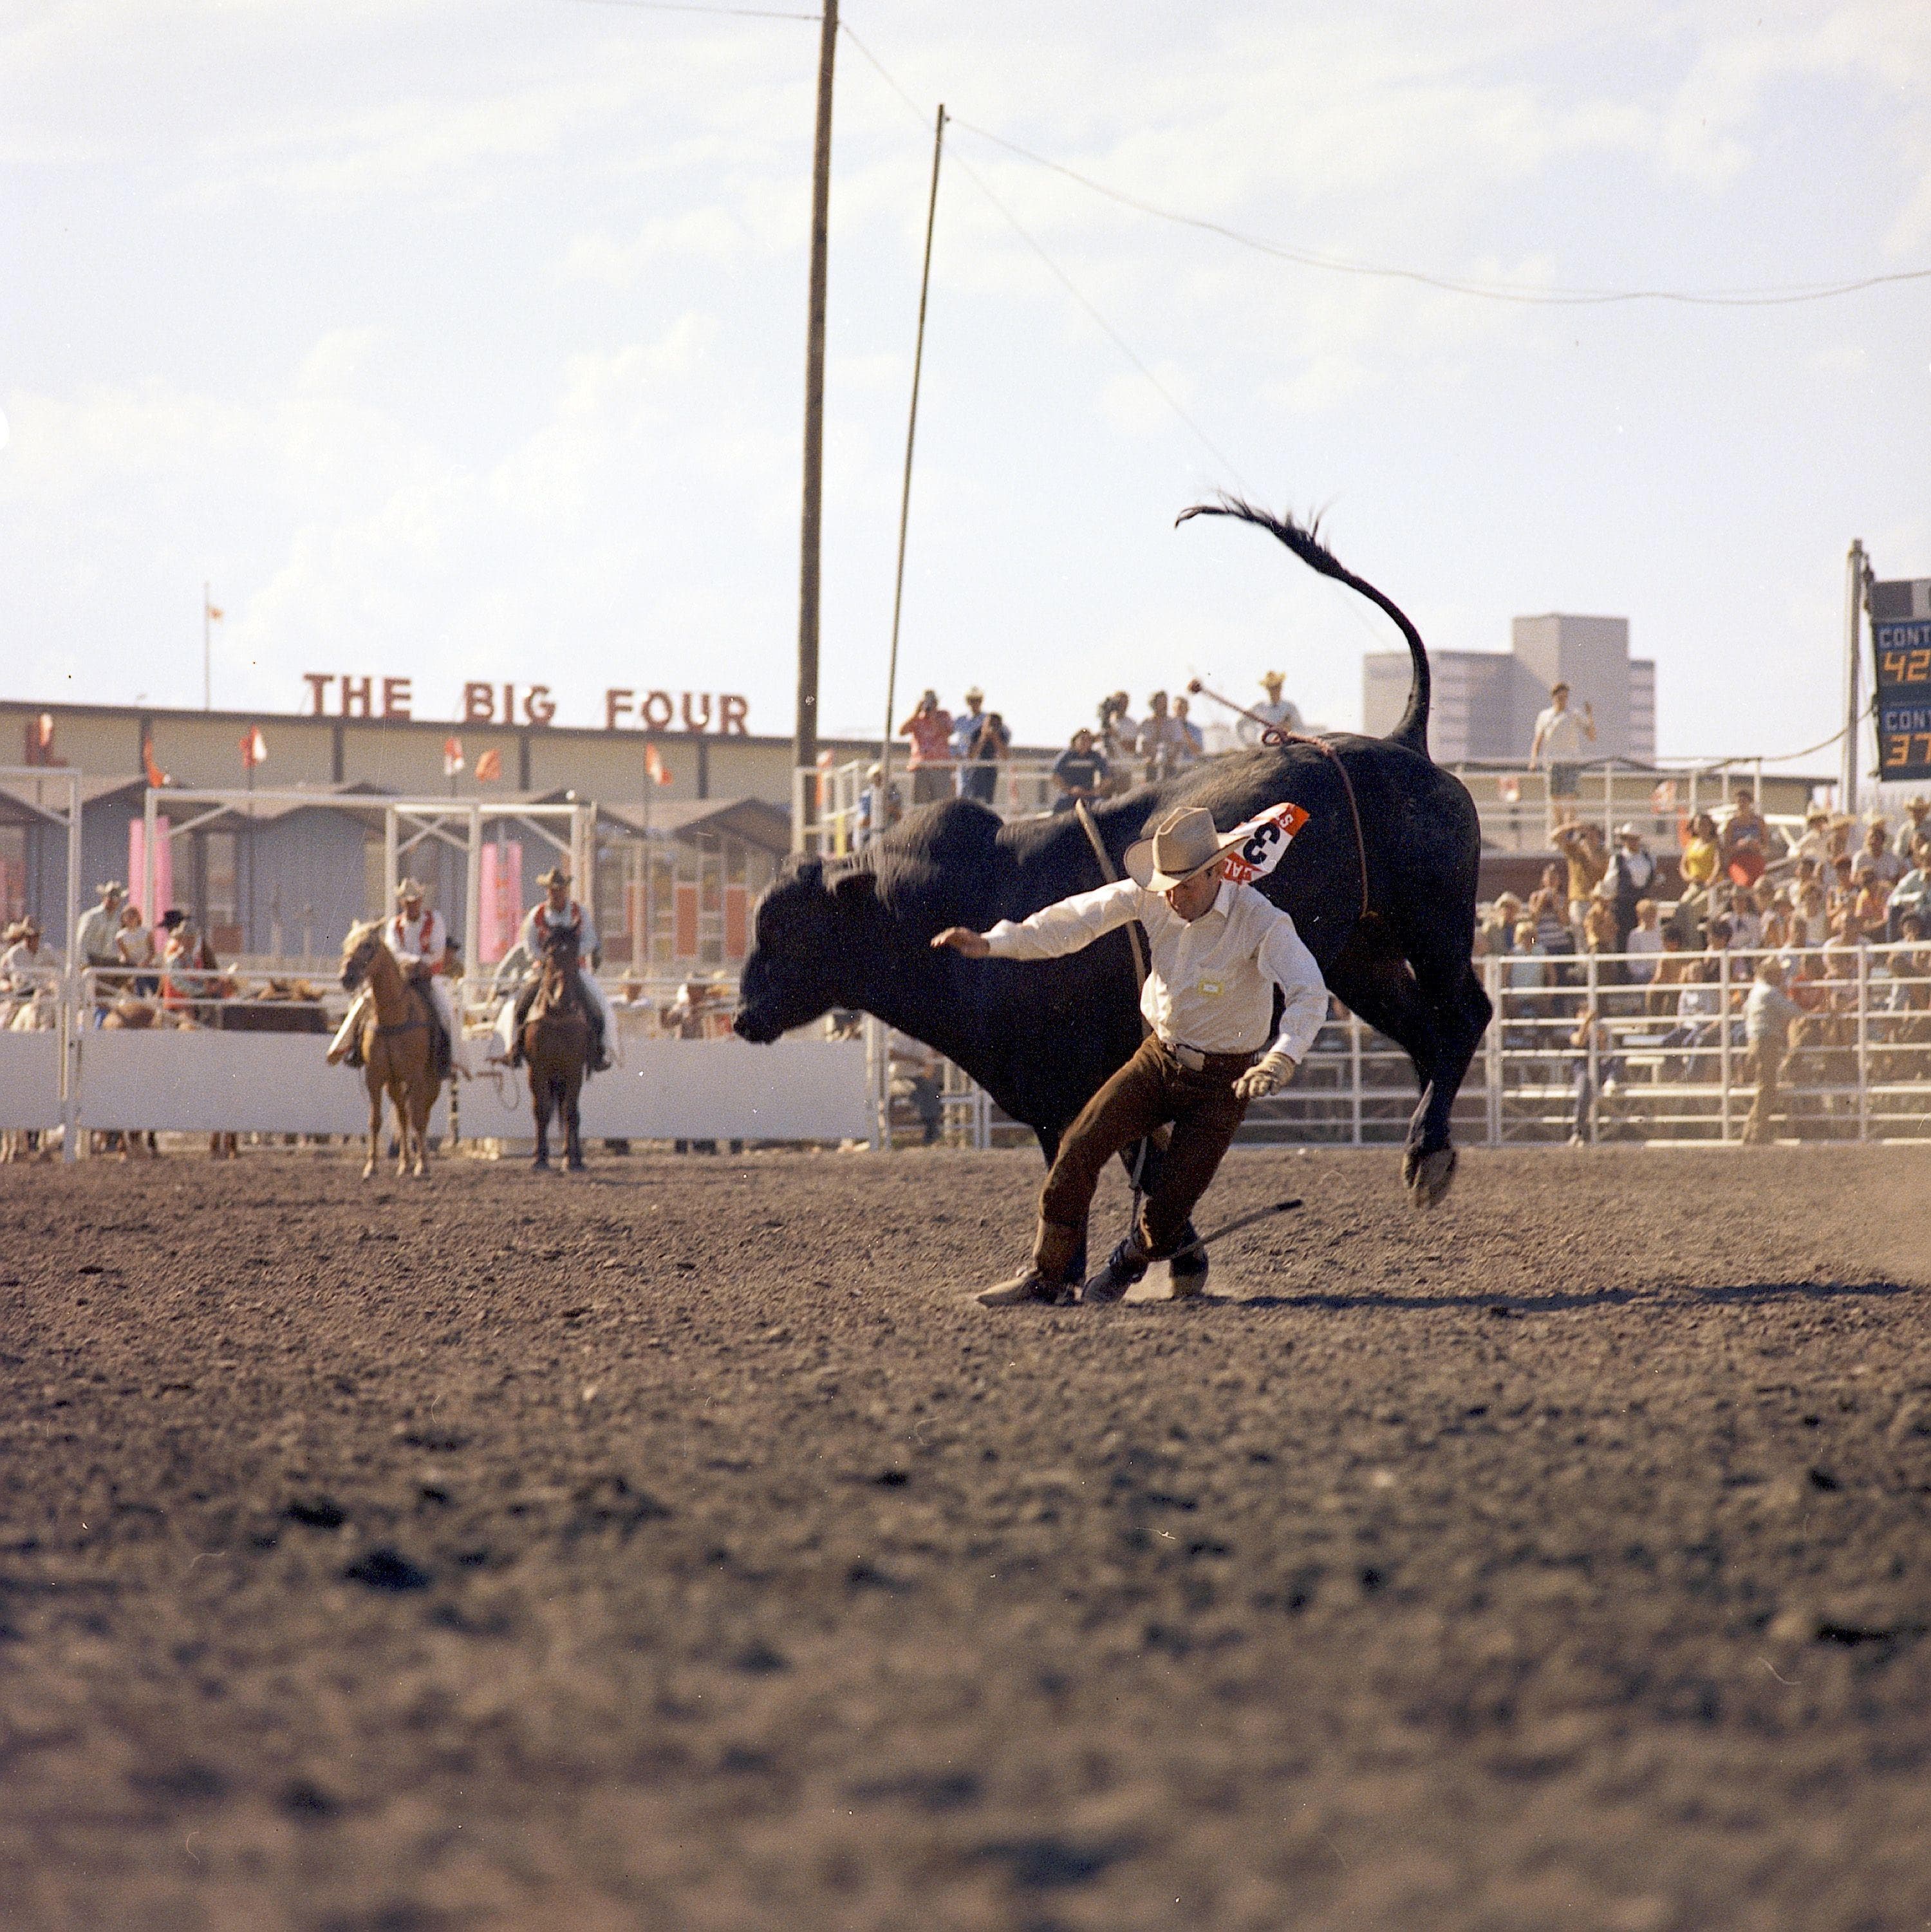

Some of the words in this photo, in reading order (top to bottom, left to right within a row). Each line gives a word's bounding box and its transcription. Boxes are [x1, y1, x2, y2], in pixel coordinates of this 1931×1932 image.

[1883, 649, 1931, 682] 42
[304, 673, 412, 719] THE
[463, 681, 556, 726] BIG
[606, 688, 749, 736] FOUR
[1885, 709, 1931, 731] CON
[1885, 733, 1931, 767] 37
[1243, 822, 1280, 865] 3
